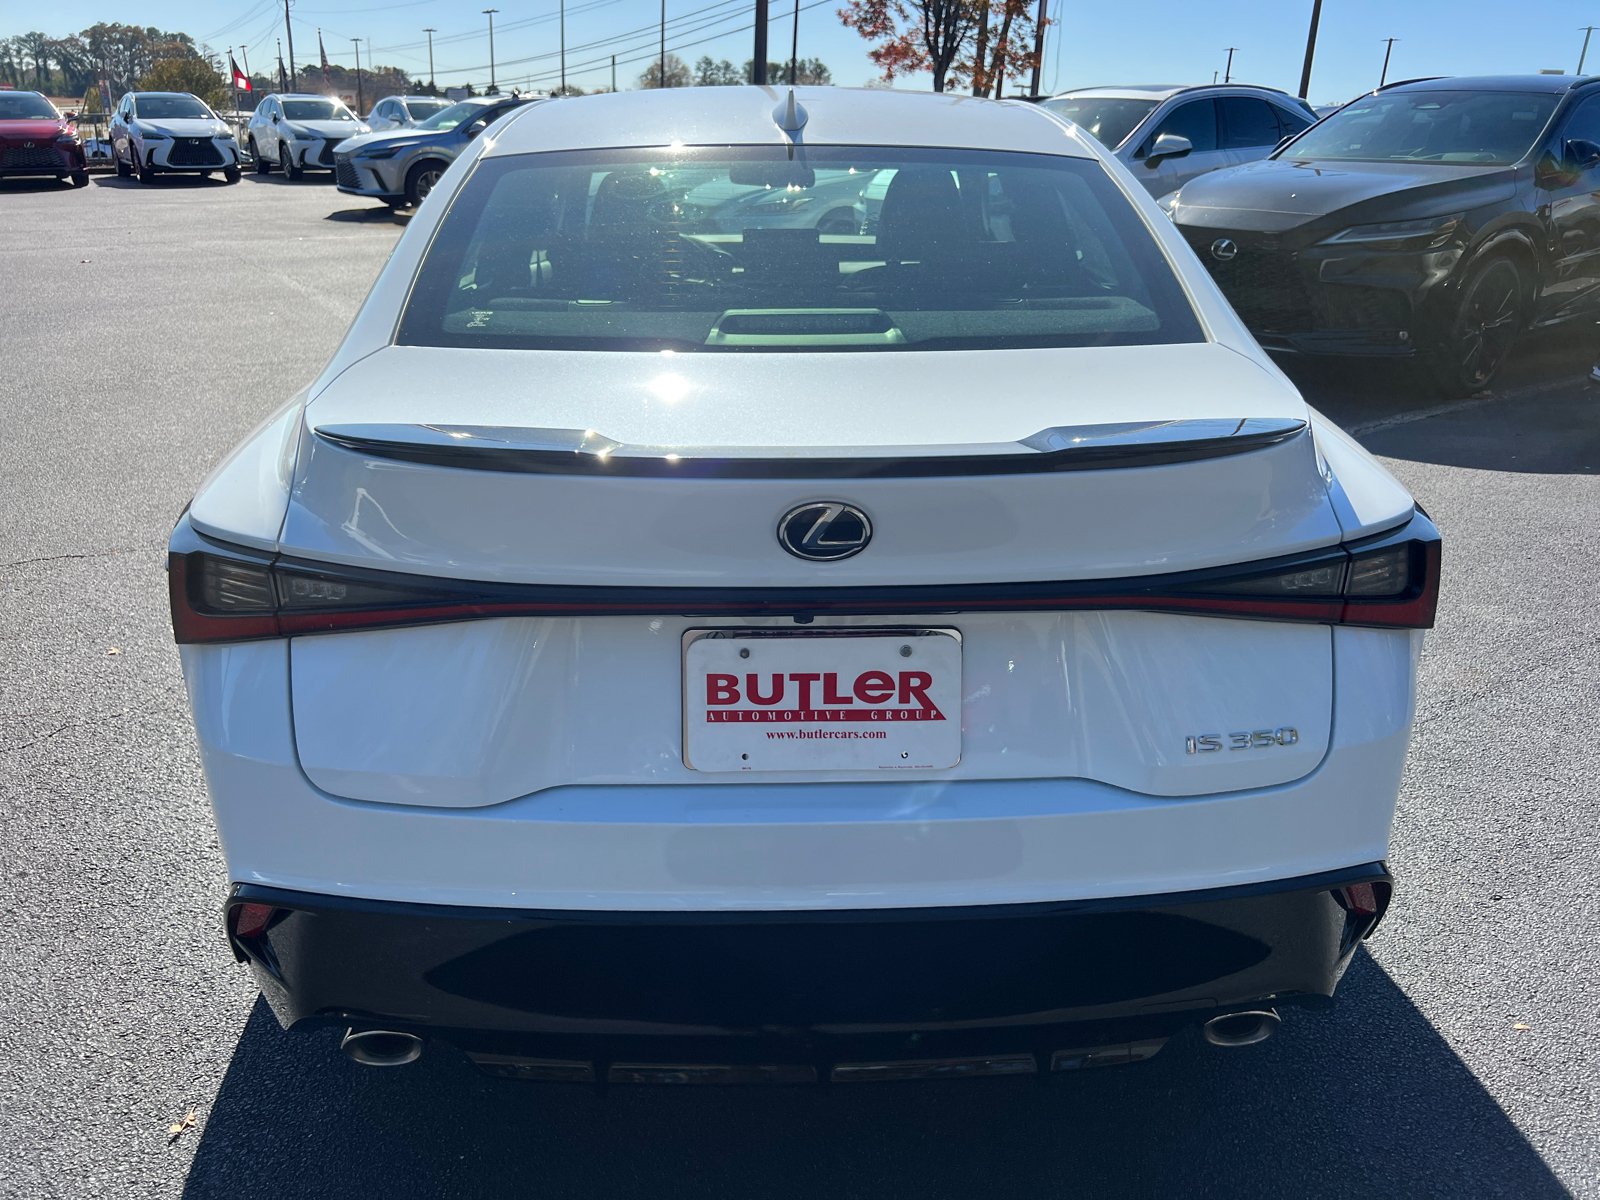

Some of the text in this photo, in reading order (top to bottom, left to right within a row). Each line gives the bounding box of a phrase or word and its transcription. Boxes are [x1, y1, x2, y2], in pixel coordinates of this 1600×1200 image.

[708, 710, 937, 721] AUTOMOTIVE GROUP
[766, 729, 887, 739] www.butlercars.com
[1185, 726, 1299, 754] IS 350
